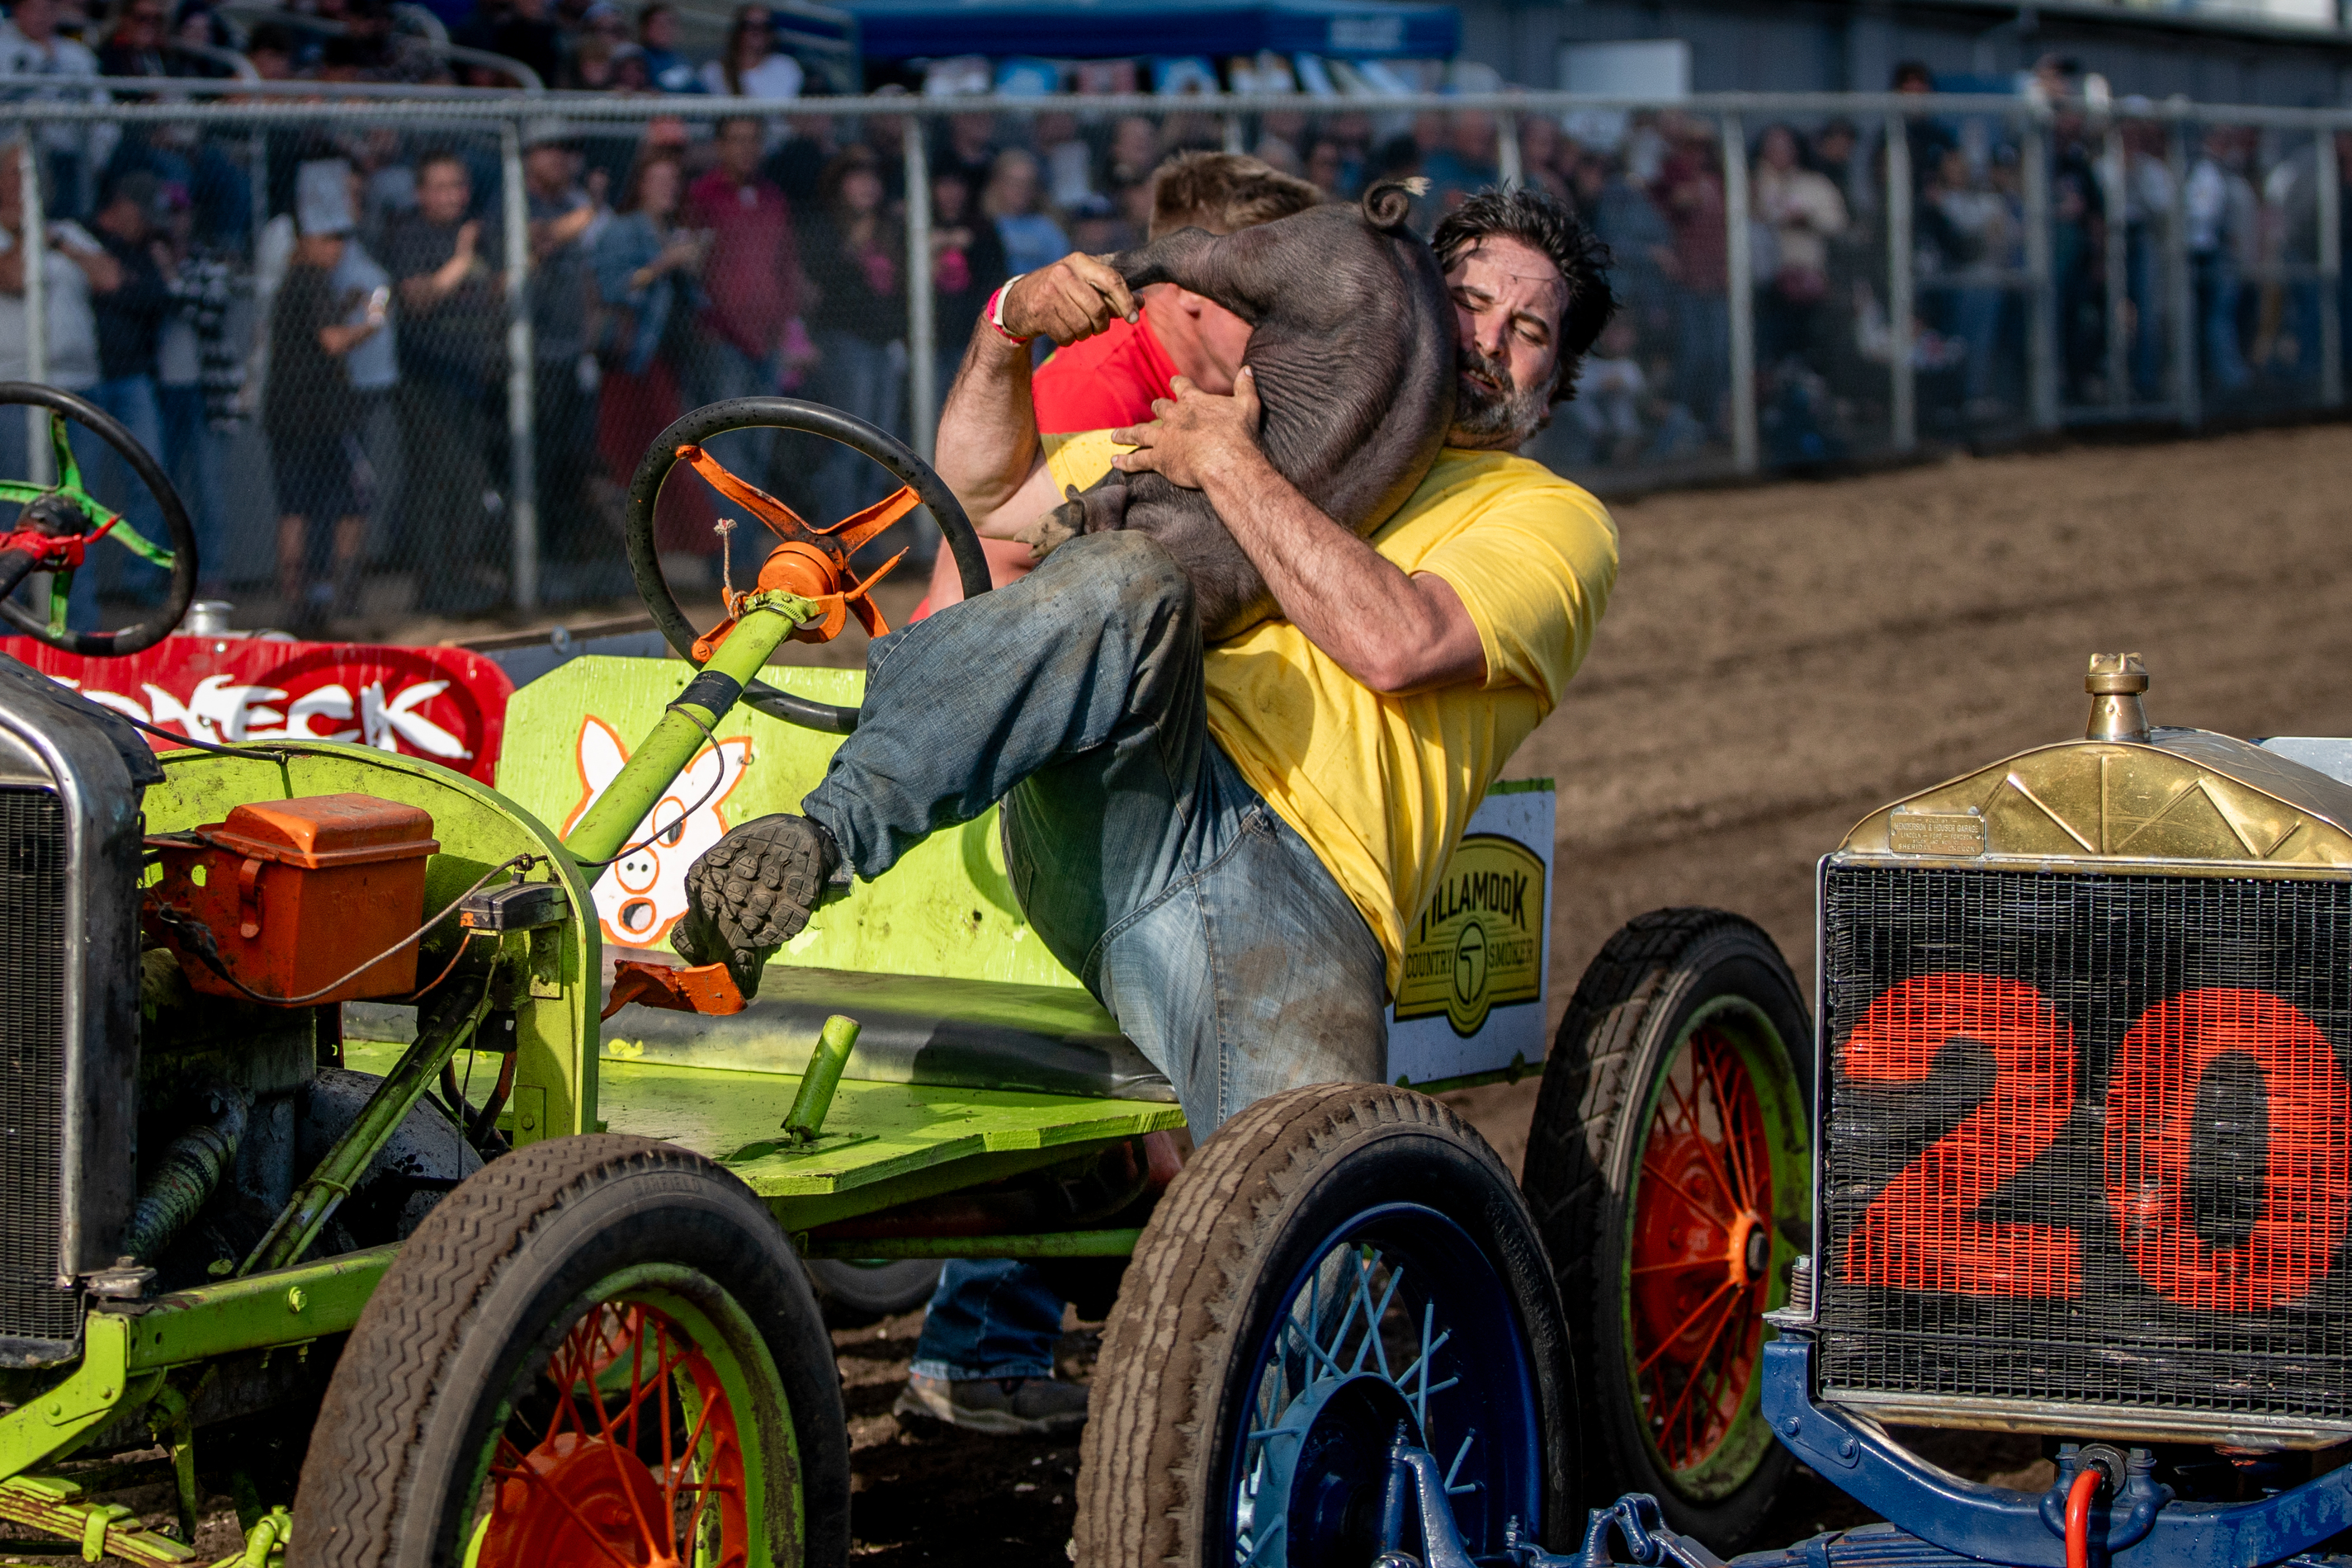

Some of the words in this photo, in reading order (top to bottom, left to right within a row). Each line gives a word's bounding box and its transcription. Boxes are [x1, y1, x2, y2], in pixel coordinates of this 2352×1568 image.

[1894, 822, 1926, 831] HENDERSON
[1934, 824, 1955, 833] HOUSER
[1957, 824, 1979, 834] GARAGE
[1405, 949, 1453, 980] COUNTRY
[1488, 938, 1534, 969] SMOKER
[1844, 972, 2351, 1313] 20
